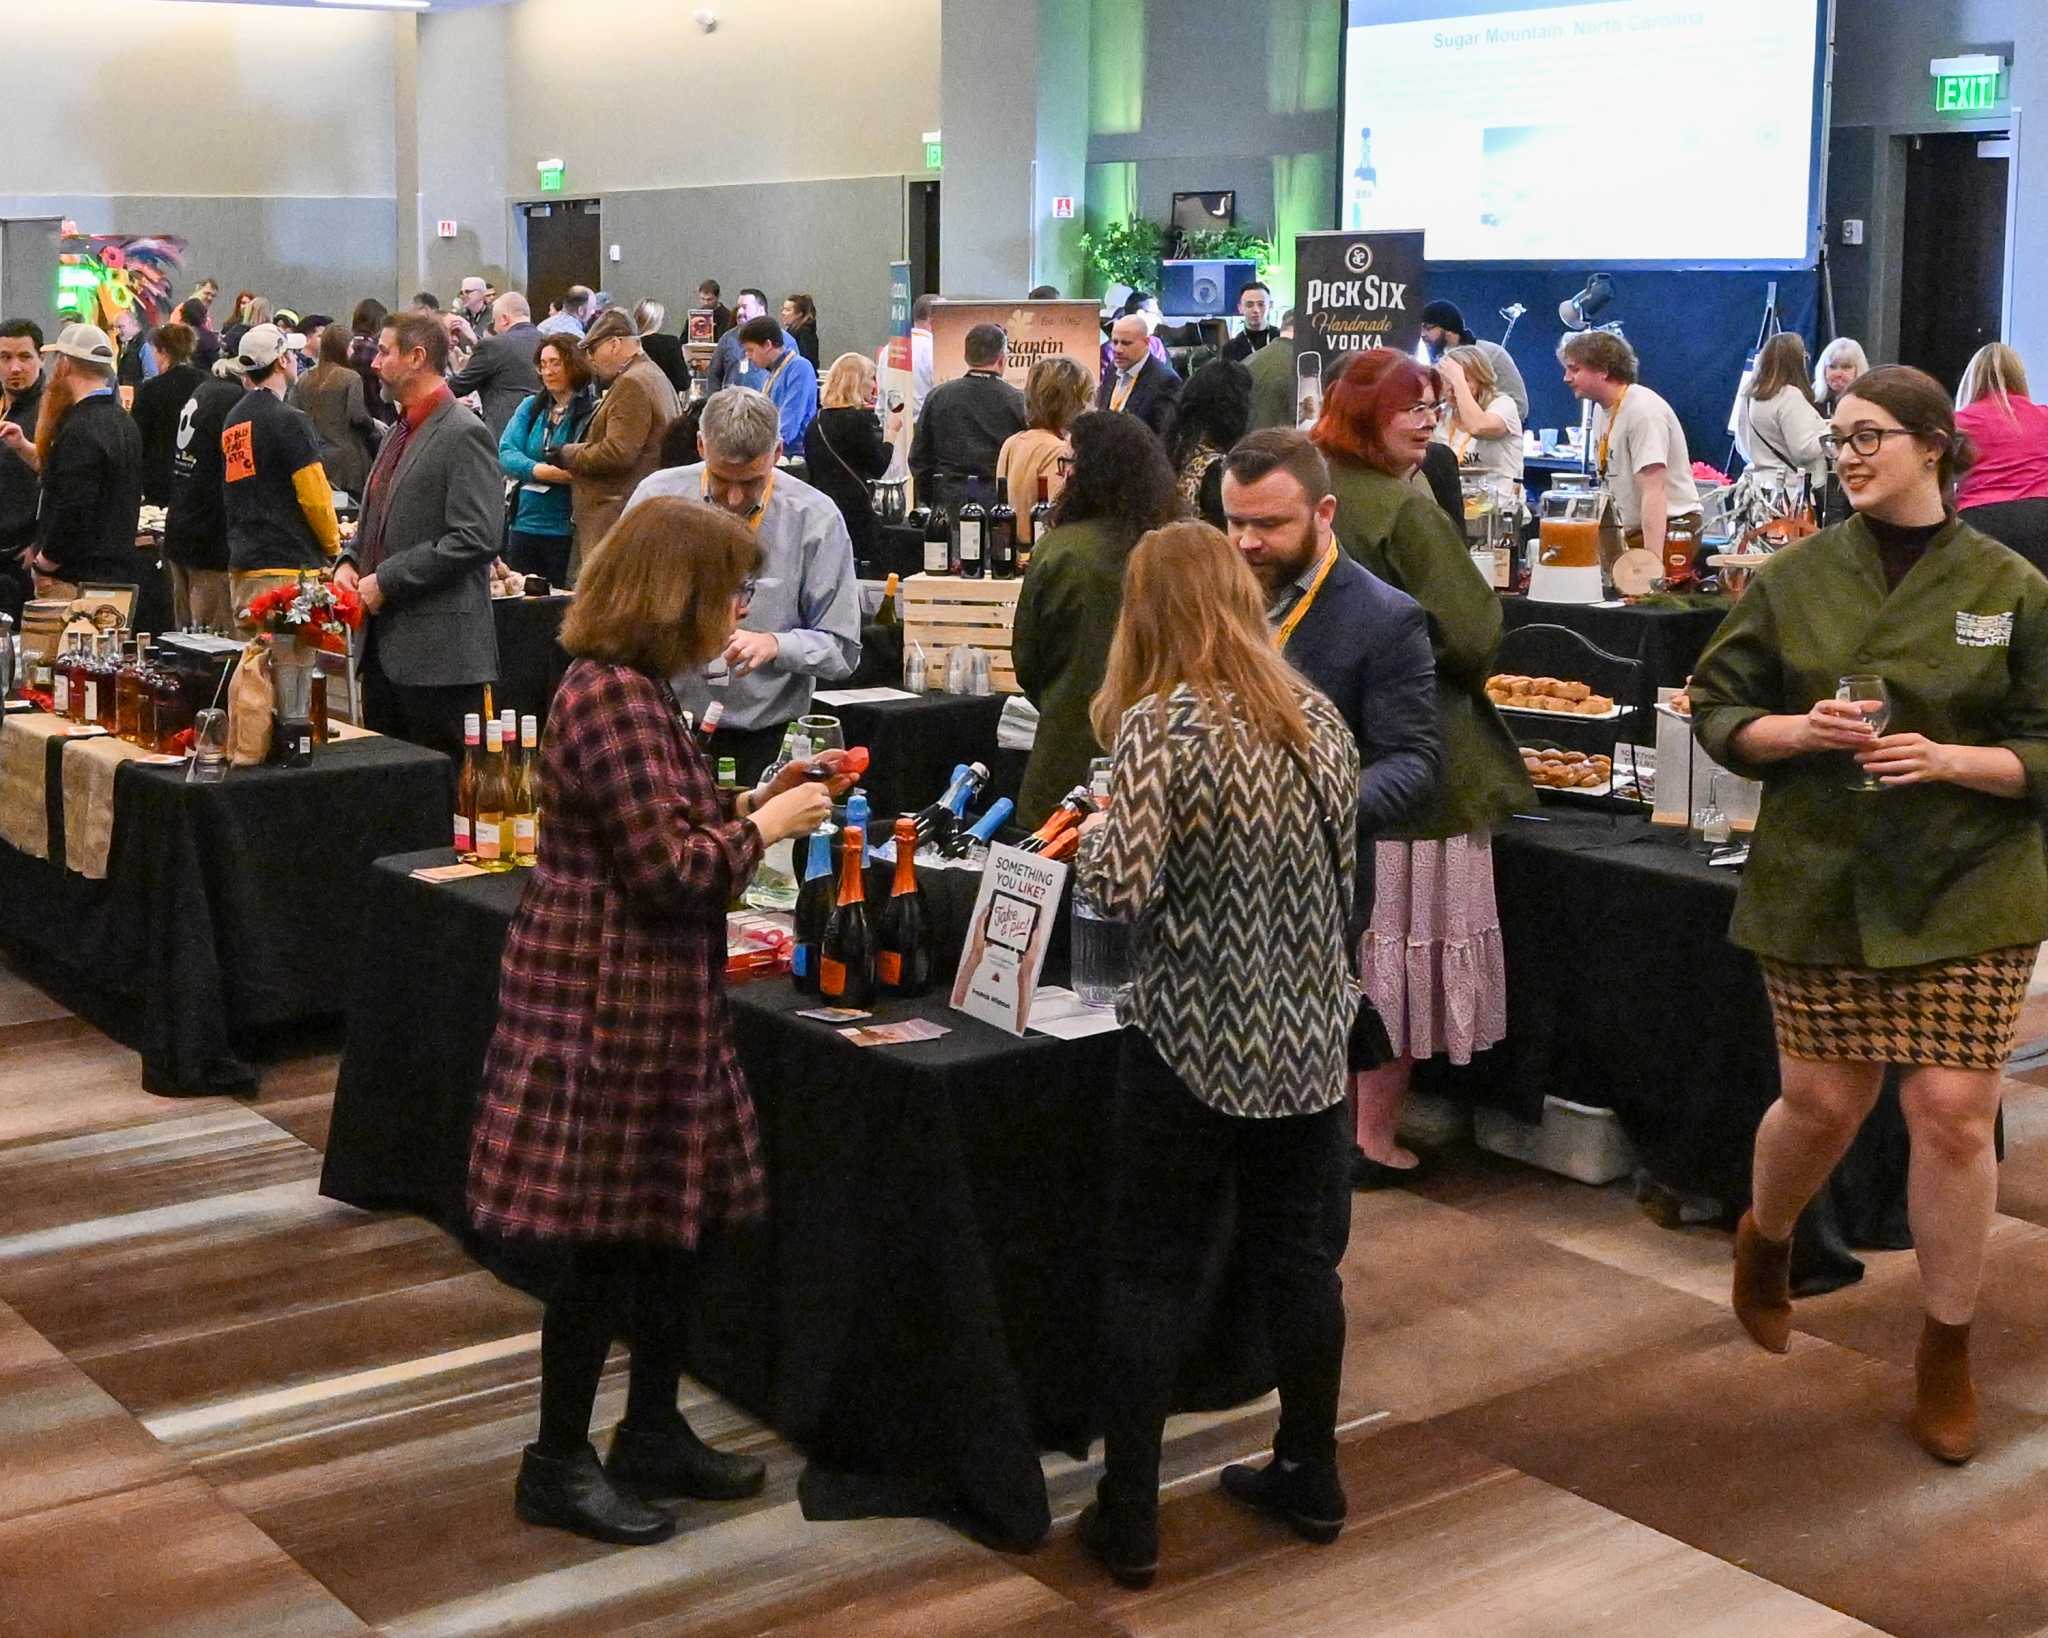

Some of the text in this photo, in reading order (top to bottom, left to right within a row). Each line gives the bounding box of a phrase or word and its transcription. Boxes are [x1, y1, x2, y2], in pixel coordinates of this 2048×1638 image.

[1433, 32, 1479, 50] Sugar
[1573, 18, 1622, 35] North
[1628, 11, 1705, 32] Carolina
[1944, 77, 1990, 108] EXIT
[1306, 274, 1407, 315] PICK SIX
[1312, 312, 1392, 335] Handmade
[1007, 336, 1064, 354] stantin
[1326, 334, 1384, 350] VODKA
[996, 857, 1053, 886] SOMETHING
[996, 872, 1046, 900] YOU LIKE?
[994, 904, 1018, 927] Take
[1000, 917, 1031, 937] a pic!
